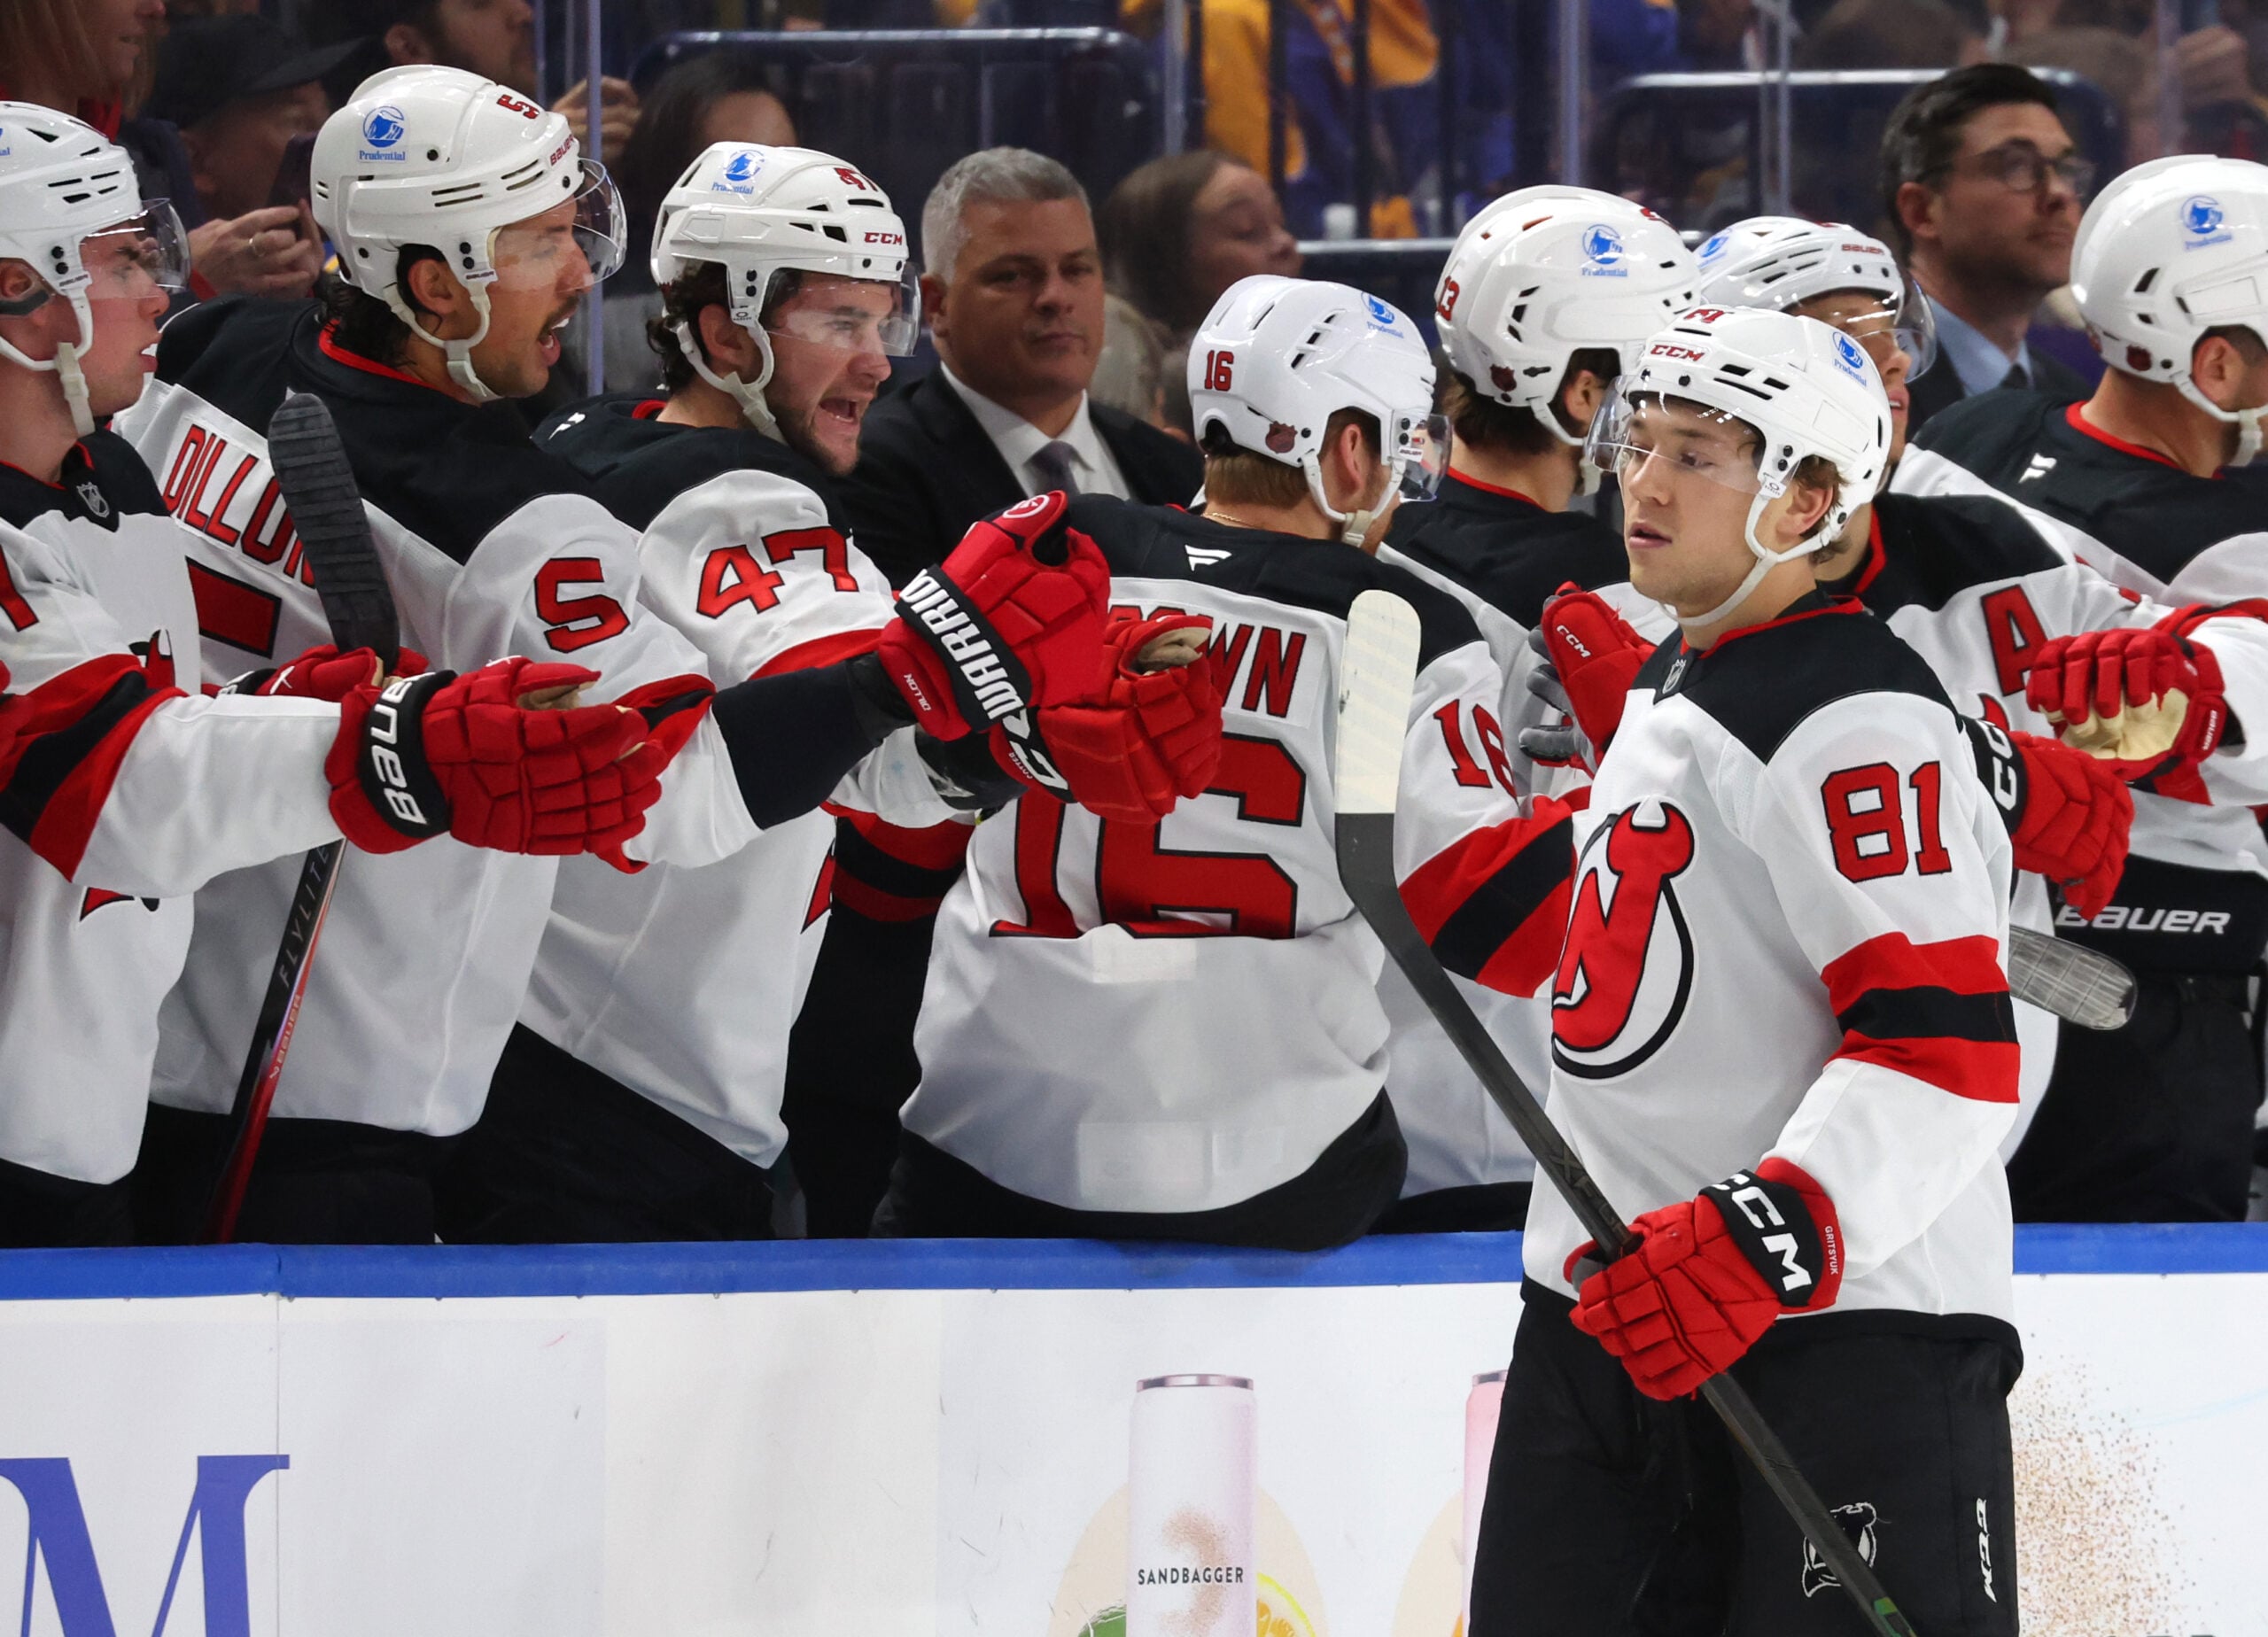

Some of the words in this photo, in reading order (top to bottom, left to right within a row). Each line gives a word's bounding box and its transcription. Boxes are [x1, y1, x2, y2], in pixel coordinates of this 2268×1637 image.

[359, 150, 406, 161] Prudential
[864, 232, 903, 245] CCM
[1204, 350, 1234, 392] 16
[1650, 345, 1705, 361] CCM
[1834, 358, 1868, 387] Prudential
[696, 526, 858, 619] 47
[534, 556, 630, 654] 5
[898, 568, 1025, 720] WARRIO
[1557, 625, 1591, 658] CCM
[1981, 584, 2048, 695] A
[904, 673, 932, 712] DILLON
[370, 671, 436, 825] BAUE
[1821, 760, 1953, 883] 81
[2054, 904, 2231, 935] BAUER
[1824, 1225, 1838, 1275] GRITSYUK
[1137, 1567, 1245, 1587] SANDBAGGER
